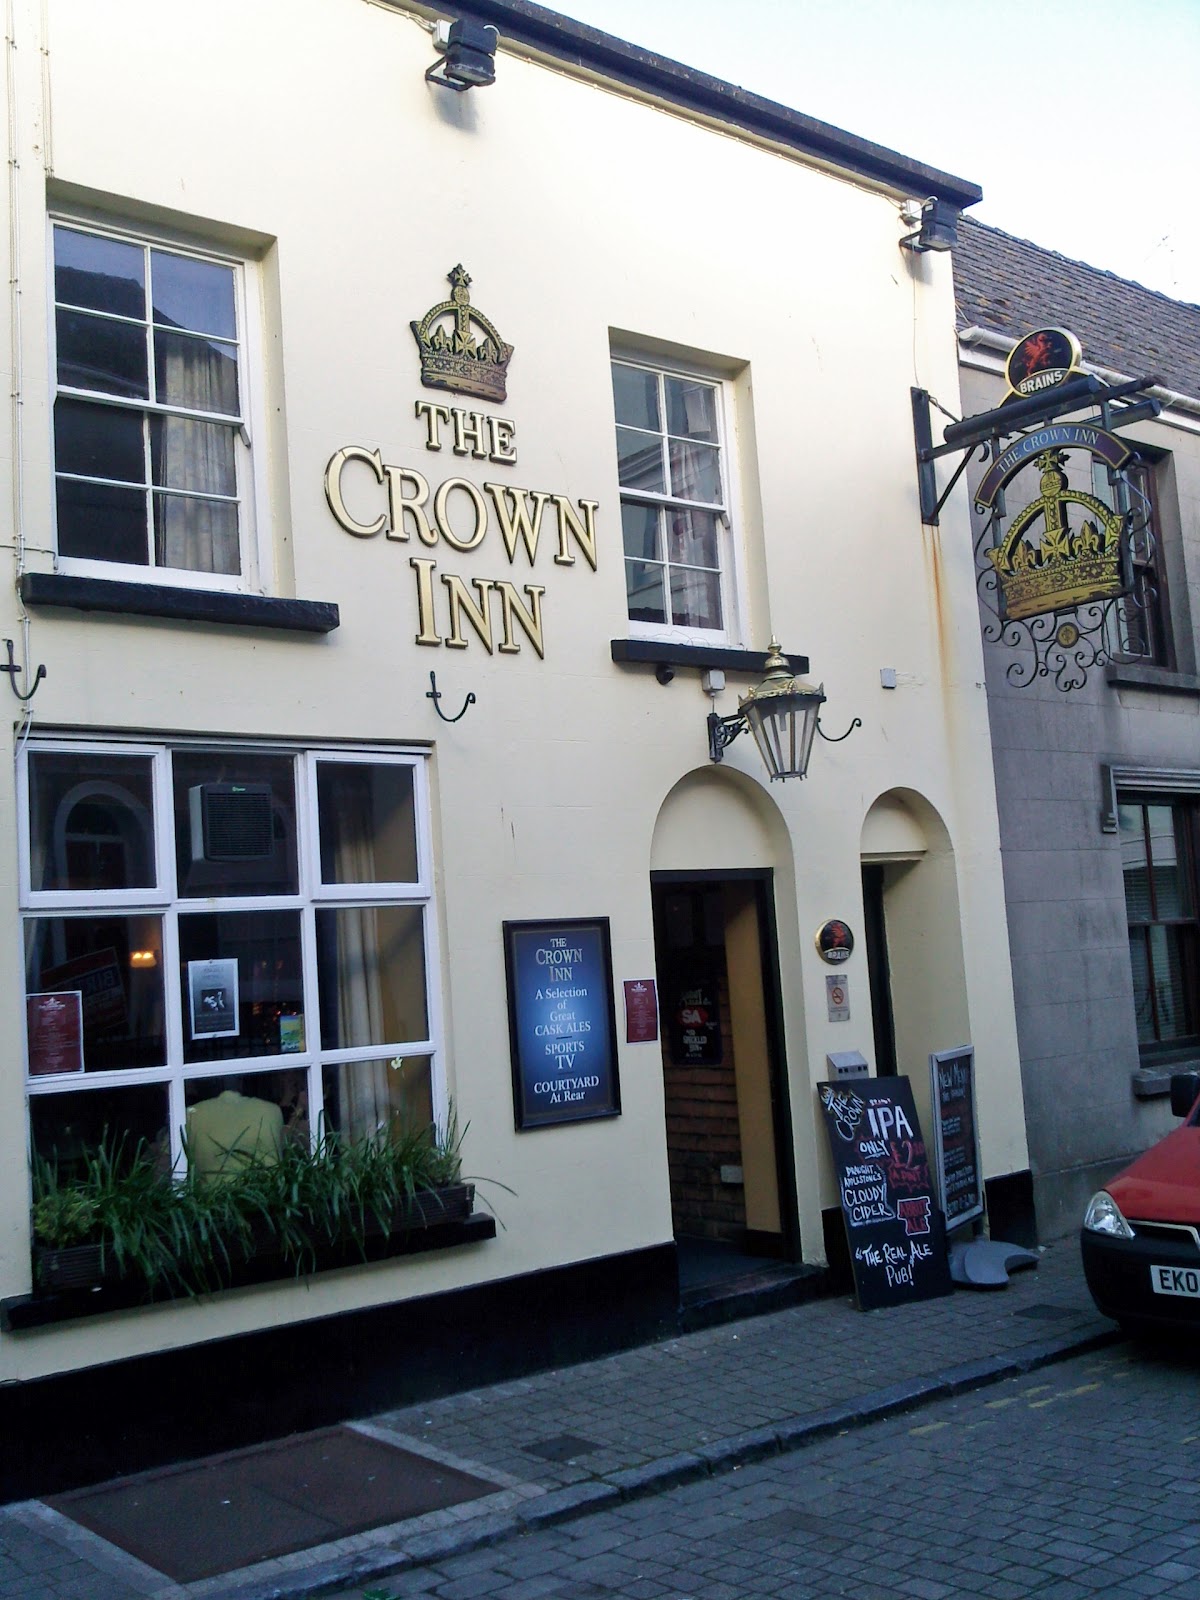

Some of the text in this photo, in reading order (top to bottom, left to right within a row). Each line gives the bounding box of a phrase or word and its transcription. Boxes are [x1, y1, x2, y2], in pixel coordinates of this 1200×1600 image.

[1019, 370, 1063, 394] BRAINS
[415, 400, 517, 464] THE
[996, 427, 1100, 474] THE CROWN INN
[324, 444, 599, 572] CROWN
[409, 556, 546, 660] INN
[550, 937, 567, 948] THE
[535, 948, 583, 966] CROWN
[549, 965, 573, 983] INN
[535, 987, 588, 1000] A Selection
[557, 999, 568, 1010] of
[550, 1011, 576, 1022] Great
[681, 1009, 702, 1024] SA
[535, 1020, 591, 1037] CASK ALES
[545, 1040, 585, 1055] SPORTS
[555, 1054, 576, 1070] TV
[533, 1075, 599, 1094] COURTYARD
[550, 1090, 586, 1104] At Rear
[828, 1092, 849, 1121] THE
[835, 1091, 864, 1141] CROWN
[866, 1105, 914, 1140] IPA
[859, 1139, 891, 1157] ONLY
[844, 1184, 885, 1208] CLOUDY
[852, 1203, 892, 1222] CIDER
